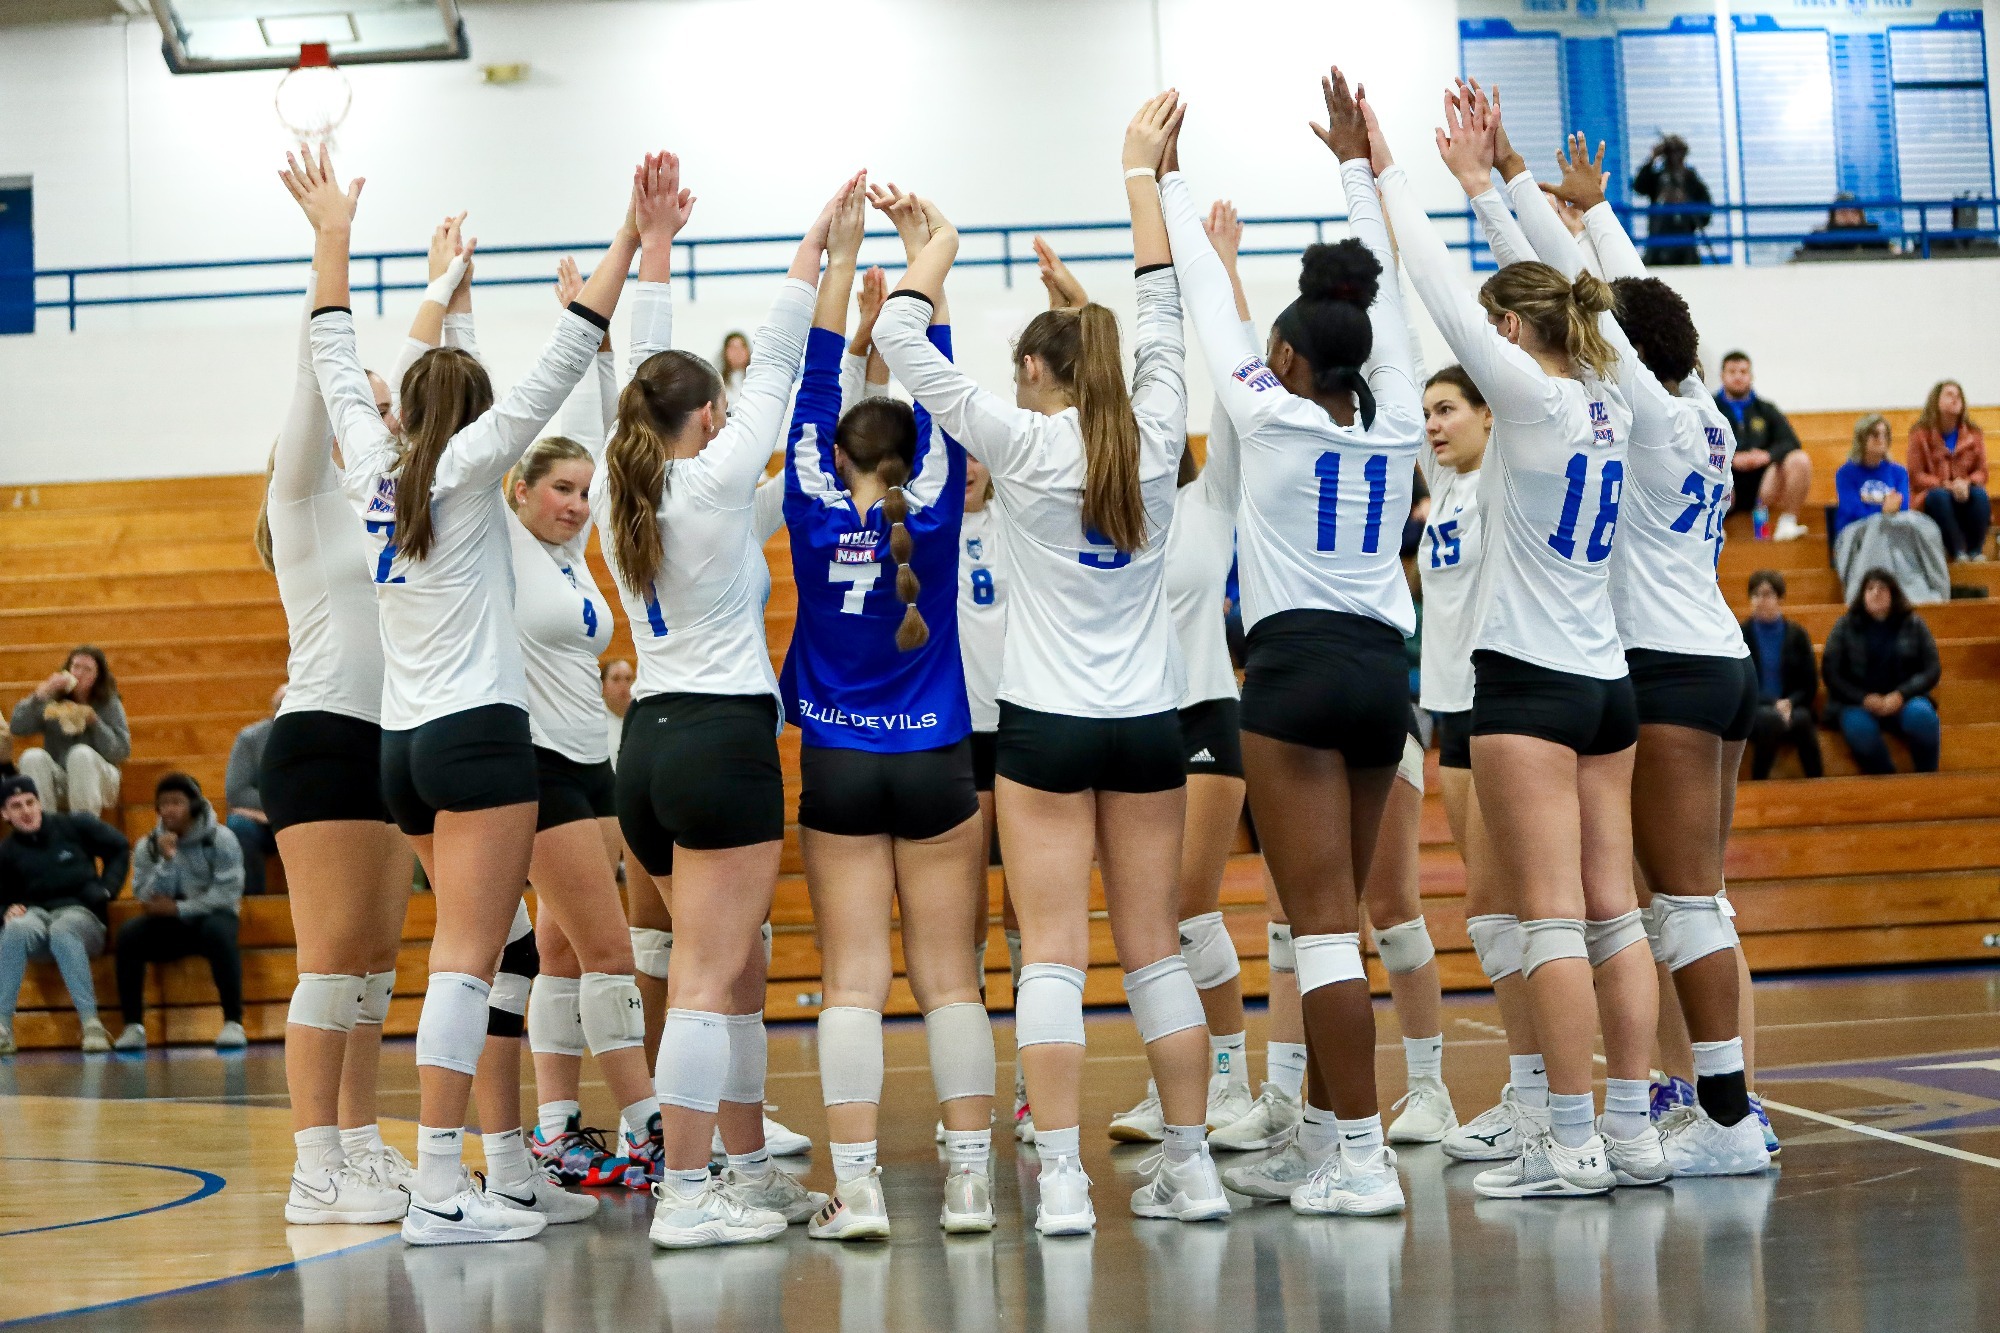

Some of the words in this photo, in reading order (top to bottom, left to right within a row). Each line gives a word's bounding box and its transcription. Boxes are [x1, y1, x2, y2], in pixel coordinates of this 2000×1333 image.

[1249, 371, 1283, 392] HAC
[1315, 451, 1387, 553] 11
[1548, 453, 1623, 562] 18
[836, 549, 875, 563] NAIA
[839, 531, 880, 546] WHAC
[1427, 520, 1461, 568] 15
[828, 560, 881, 615] 7
[971, 568, 995, 605] 8
[583, 597, 598, 637] 4
